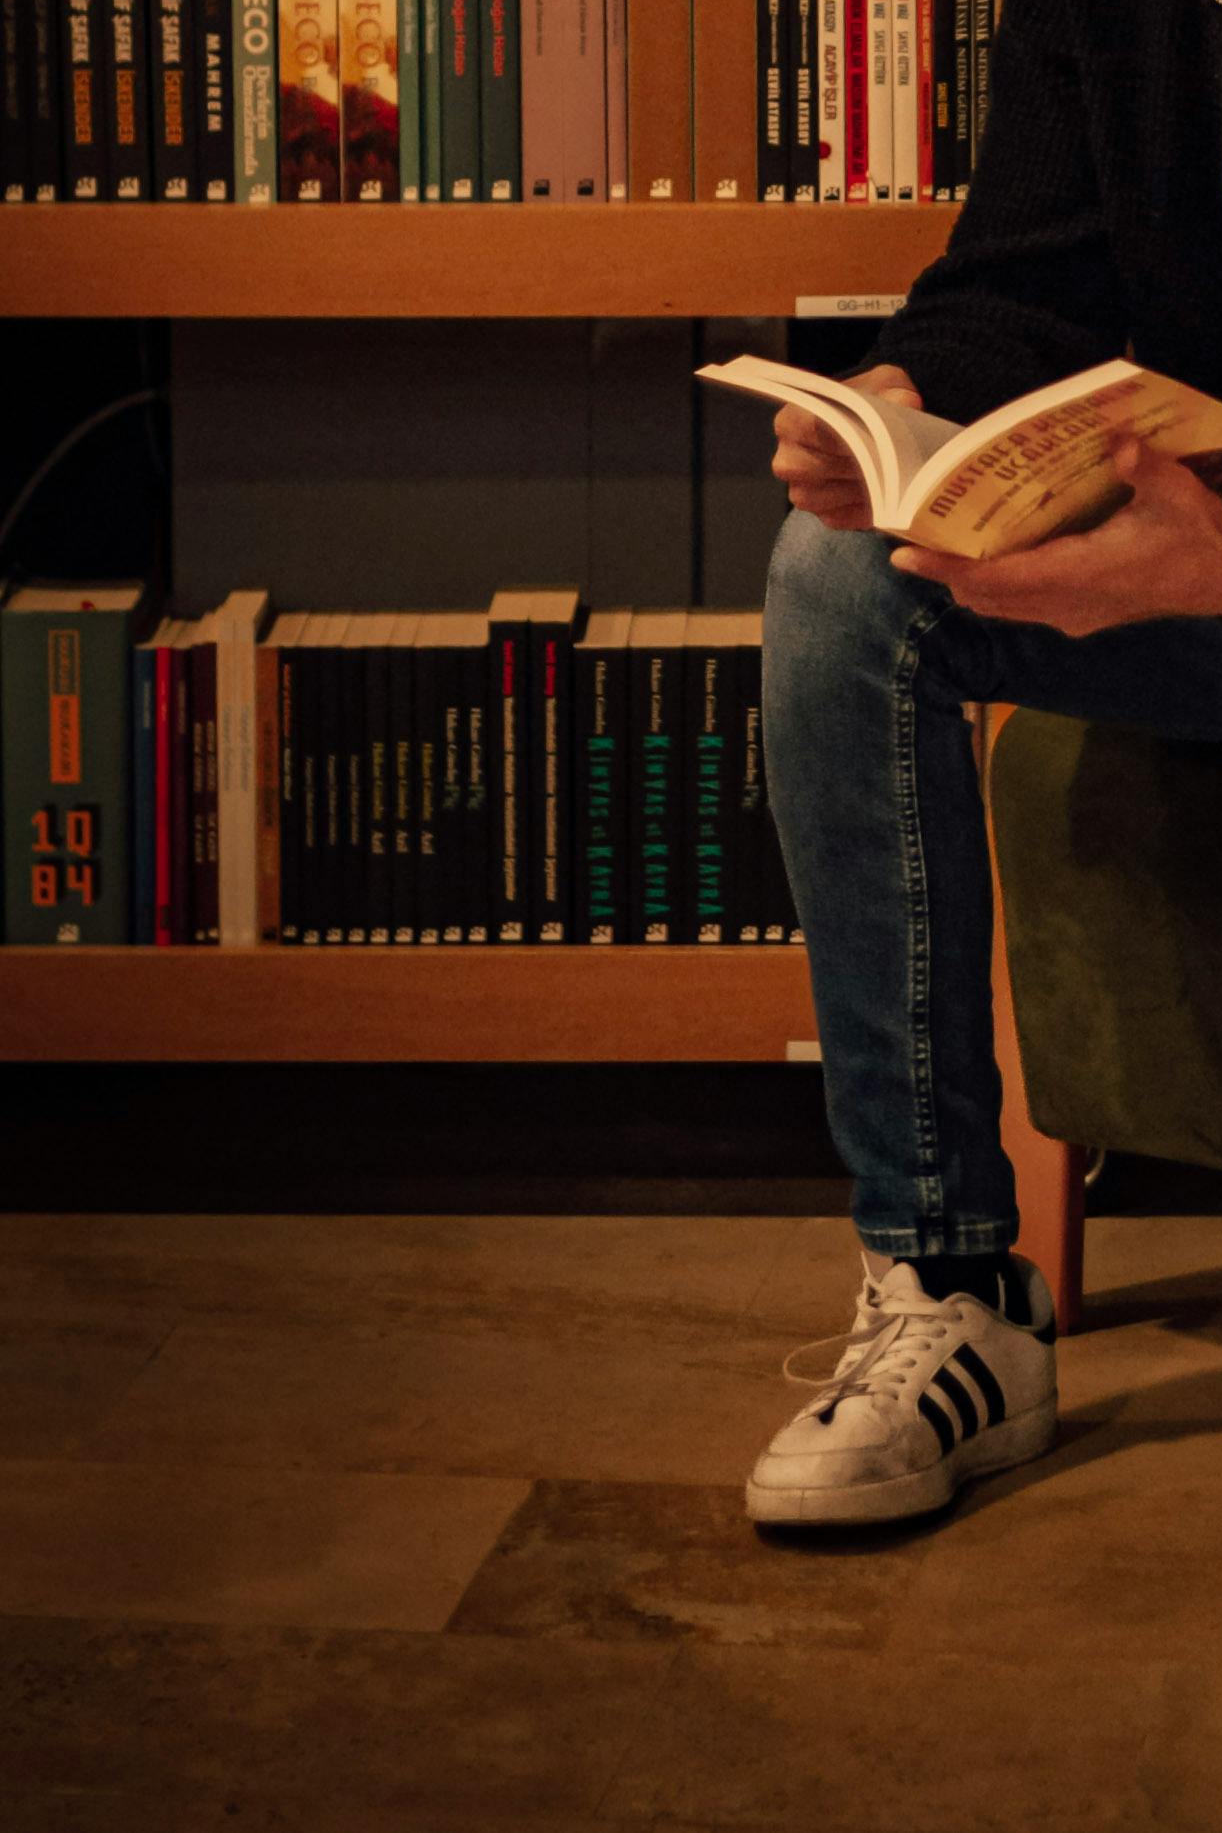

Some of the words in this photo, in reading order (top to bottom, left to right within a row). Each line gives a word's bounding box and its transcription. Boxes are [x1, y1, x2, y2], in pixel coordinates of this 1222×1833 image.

[70, 14, 89, 63] ŞAFAK
[113, 14, 132, 63] ŞAFAK
[161, 16, 180, 63] ŞAFAK
[295, 2, 321, 67] ECO
[356, 2, 383, 67] ECO
[824, 0, 836, 33] ATASOY
[207, 33, 221, 132] MAHREM
[767, 67, 781, 100] SEVİL
[797, 67, 810, 100] SEVİL
[824, 45, 836, 85] ACAYİP
[956, 48, 968, 91] NEDİM
[73, 70, 92, 145] İSKENDER
[116, 69, 135, 145] İSKENDER
[164, 70, 183, 146] İSKENDER
[767, 102, 780, 147] ATASOY
[797, 102, 810, 147] ATASOY
[822, 88, 836, 120] İŞLER
[956, 95, 968, 141] GÜRSEL
